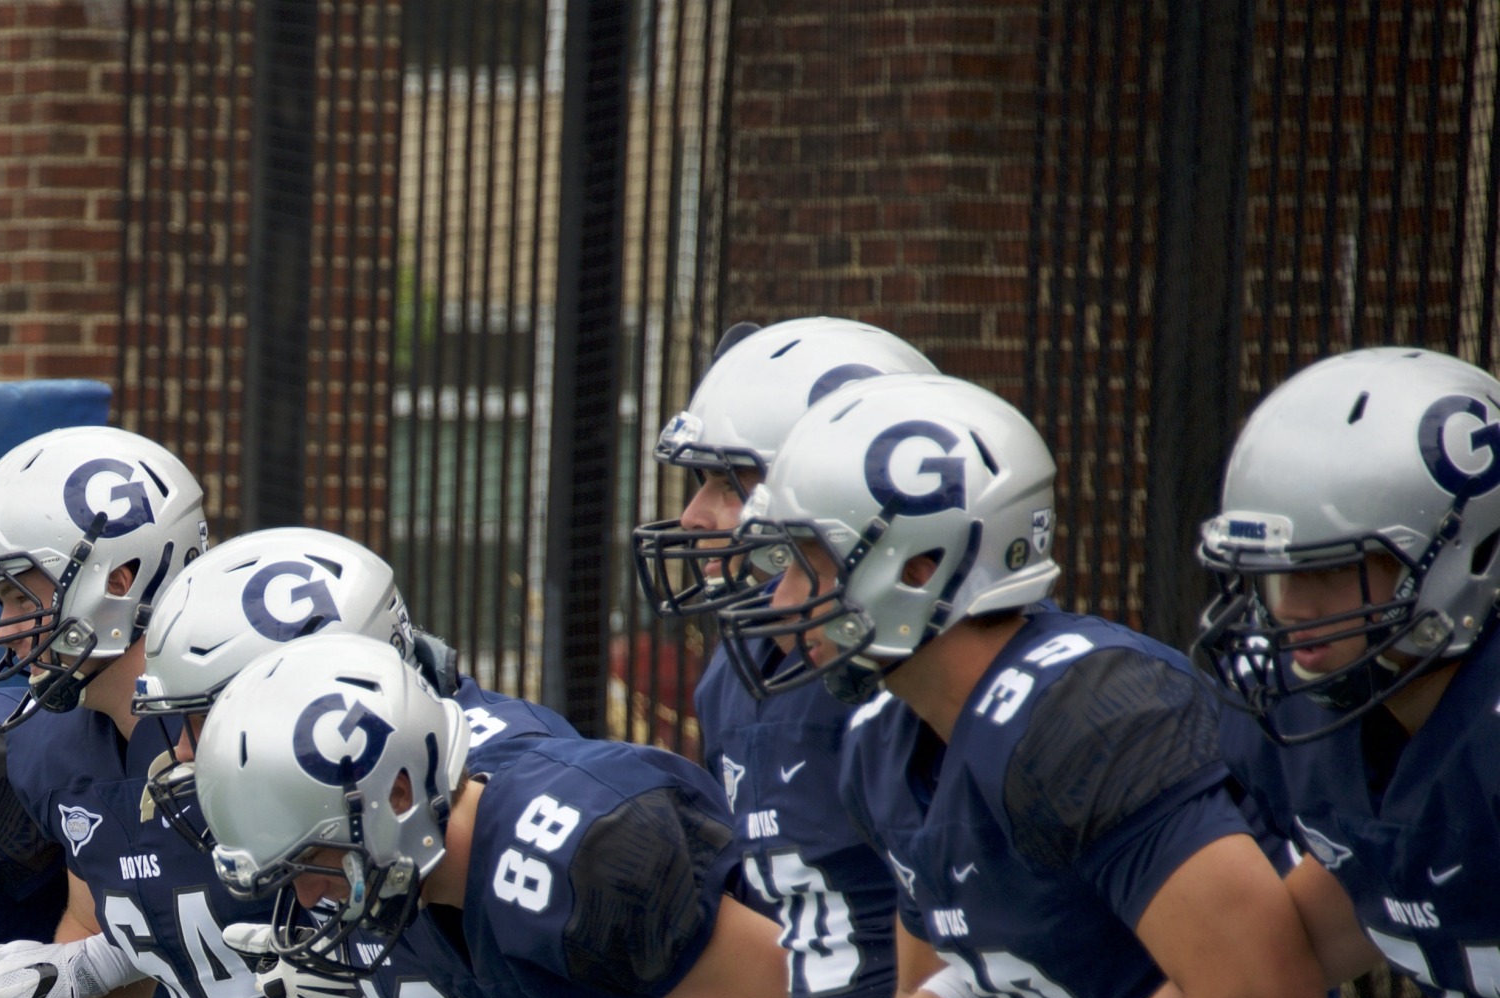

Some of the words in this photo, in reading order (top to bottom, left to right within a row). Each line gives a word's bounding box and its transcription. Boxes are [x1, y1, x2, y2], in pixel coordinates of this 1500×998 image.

[864, 420, 967, 517] G
[1417, 394, 1500, 498] G
[63, 458, 157, 539] G
[242, 561, 342, 642] G
[293, 693, 396, 787] G
[492, 793, 582, 913] 88
[747, 808, 780, 839] HOYAS
[118, 854, 161, 880] HOYAS
[932, 907, 969, 937] HOYAS
[1384, 896, 1441, 929] HOYAS
